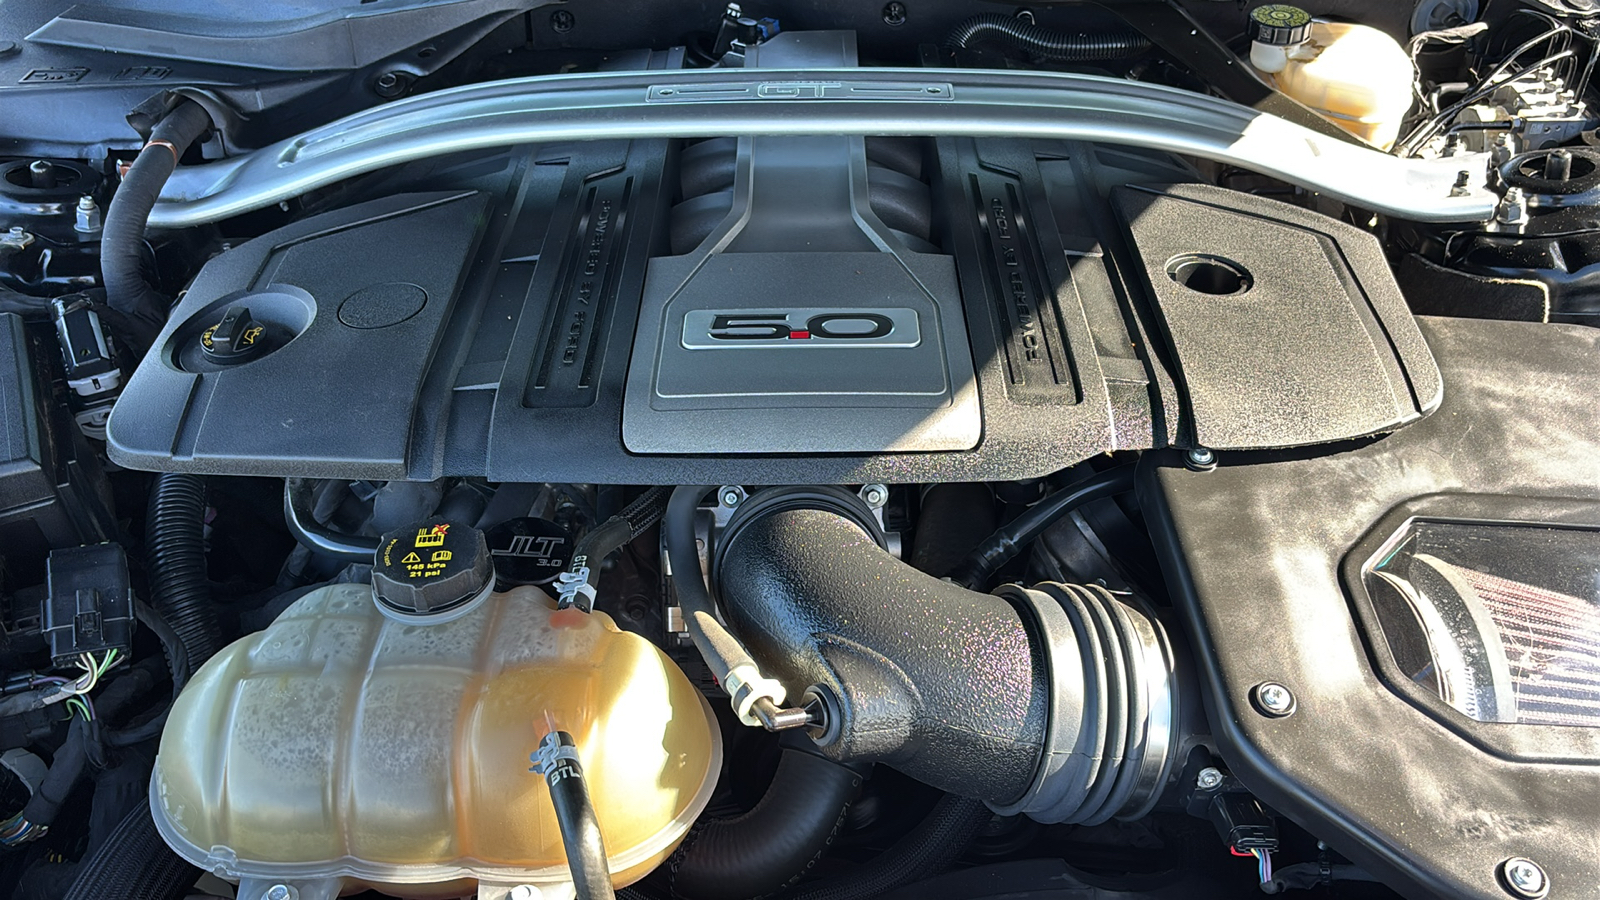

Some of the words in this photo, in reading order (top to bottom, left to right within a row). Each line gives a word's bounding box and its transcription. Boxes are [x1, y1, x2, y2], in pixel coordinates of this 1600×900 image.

[757, 82, 842, 98] GT
[991, 198, 1012, 239] FORD
[584, 200, 611, 276] POWERED
[1002, 245, 1018, 266] BY
[577, 281, 593, 305] BY
[707, 312, 895, 340] 5.0
[1009, 272, 1043, 362] POWERED
[562, 311, 586, 364] FORD
[490, 535, 565, 558] JLT
[406, 563, 424, 571] 145
[426, 562, 446, 570] kPa
[424, 569, 441, 578] psi
[536, 558, 562, 567] 3.0
[551, 765, 580, 786] BTL
